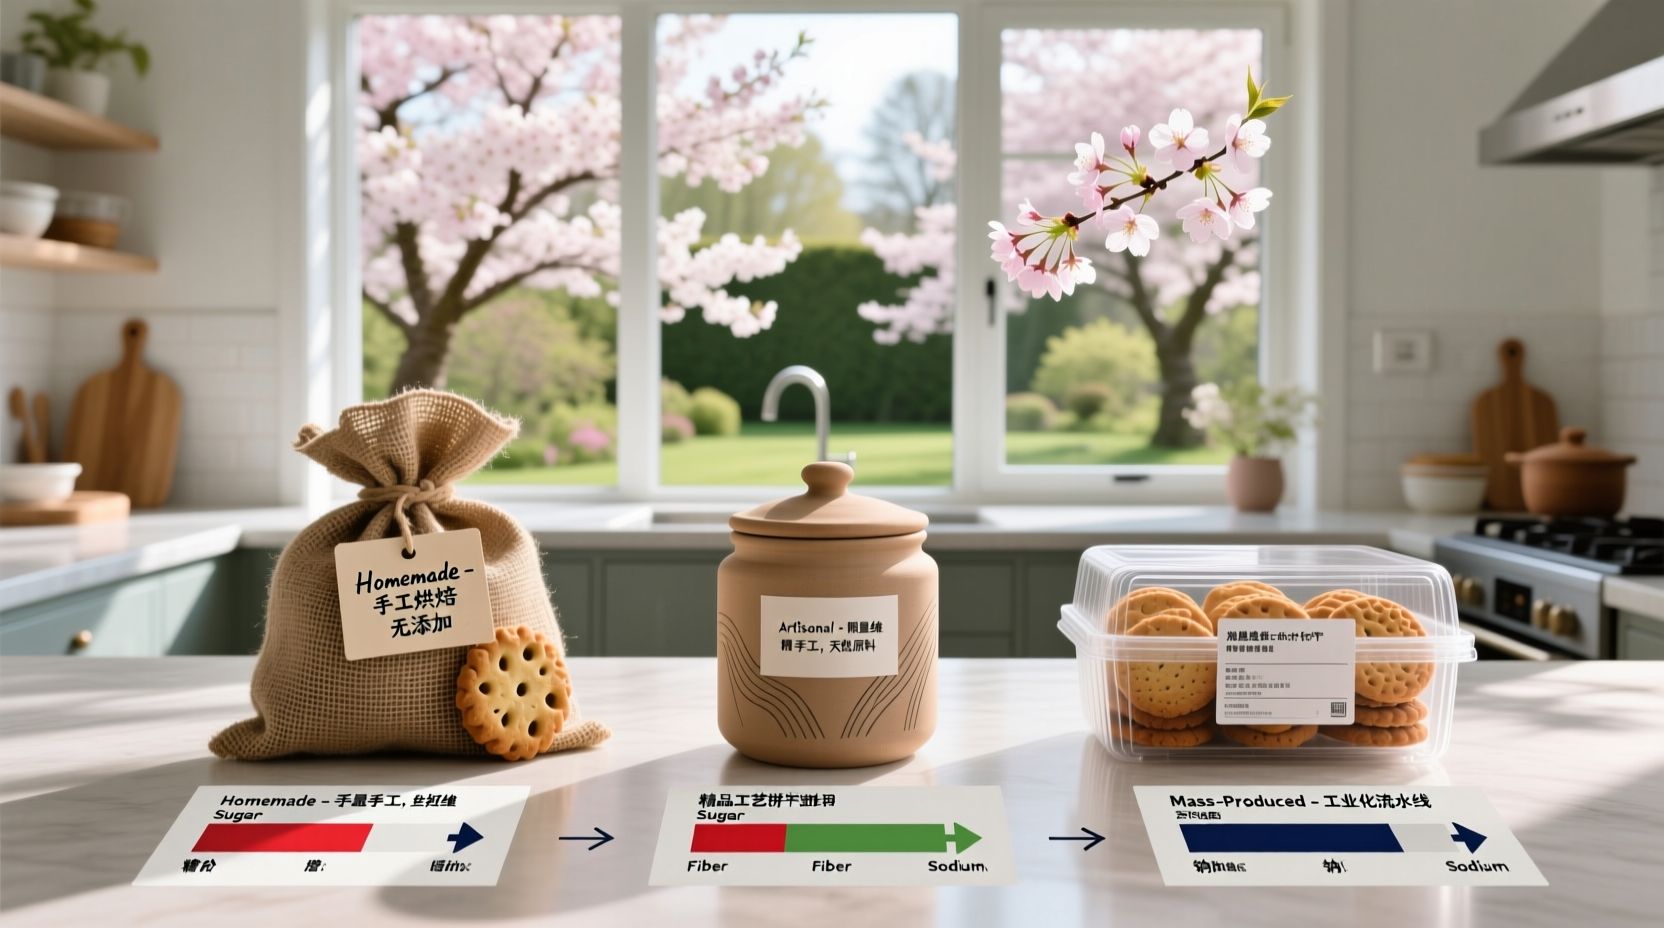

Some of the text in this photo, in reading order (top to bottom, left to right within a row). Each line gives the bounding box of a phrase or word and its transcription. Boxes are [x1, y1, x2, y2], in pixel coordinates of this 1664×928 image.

[355, 561, 460, 594] Homemade
[373, 586, 457, 615] 手工烘焙
[391, 612, 452, 638] 无添加
[220, 795, 316, 807] Homemade
[1169, 795, 1306, 807] Mass-Produced
[1323, 793, 1432, 808] 工业化流水线
[687, 859, 728, 872] Fiber
[812, 860, 852, 872] Fiber
[1446, 860, 1510, 872] Sodium
